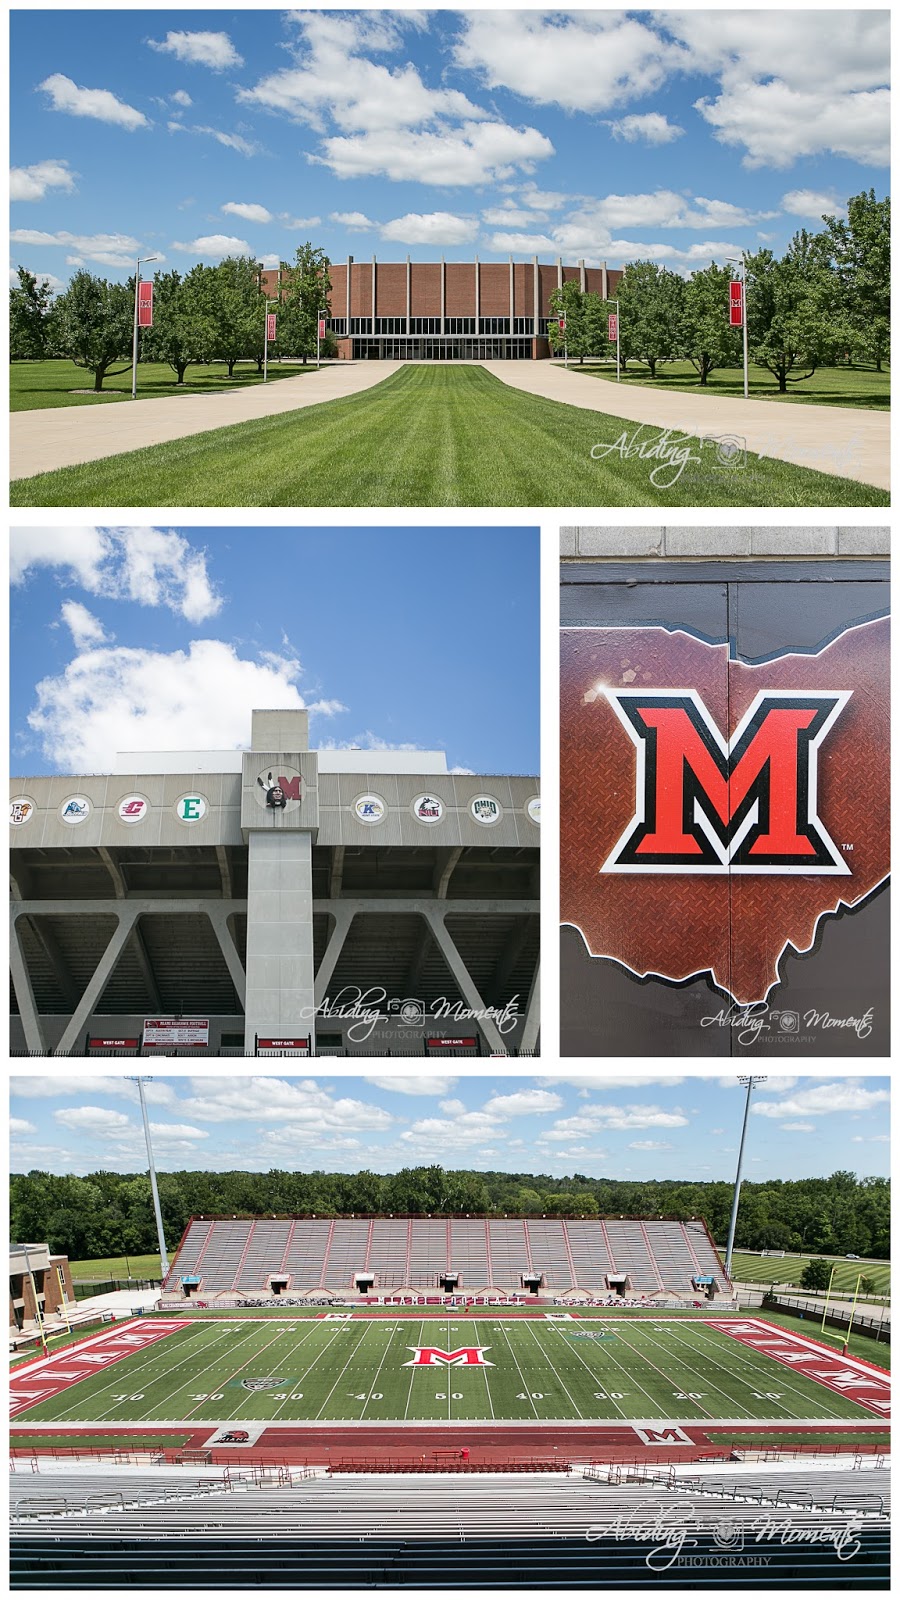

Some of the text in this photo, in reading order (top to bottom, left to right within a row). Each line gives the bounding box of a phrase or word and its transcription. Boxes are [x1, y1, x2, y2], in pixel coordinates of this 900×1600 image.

[599, 688, 854, 875] M
[278, 776, 302, 801] M
[182, 799, 201, 819] E
[363, 804, 375, 814] K
[474, 800, 497, 815] OHIO
[378, 1297, 428, 1306] MIAMI
[401, 1346, 497, 1366] M
[112, 1393, 145, 1401] 10
[354, 1392, 384, 1400] 40
[435, 1392, 464, 1400] 50
[515, 1392, 545, 1400] 40
[593, 1392, 625, 1400] 30
[672, 1392, 704, 1400] 20
[750, 1392, 781, 1400] 10
[638, 1428, 689, 1443] M
